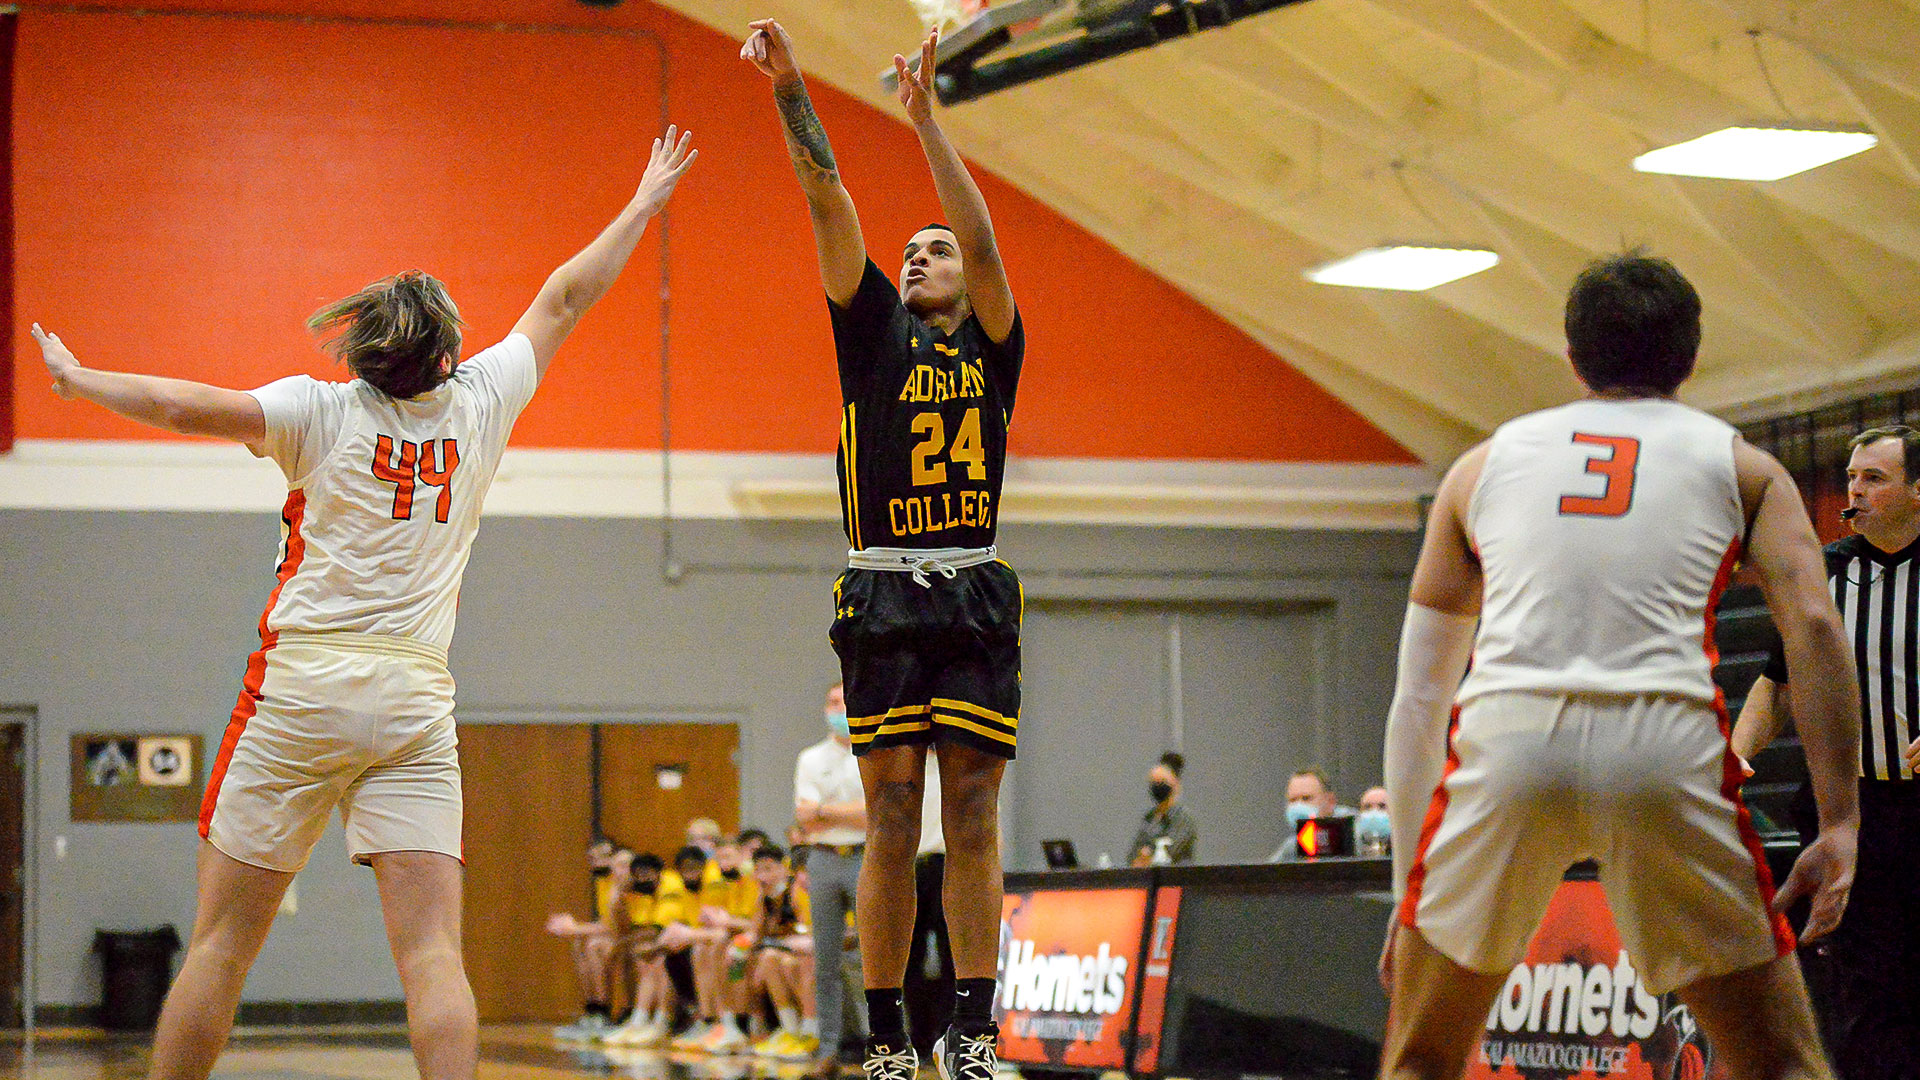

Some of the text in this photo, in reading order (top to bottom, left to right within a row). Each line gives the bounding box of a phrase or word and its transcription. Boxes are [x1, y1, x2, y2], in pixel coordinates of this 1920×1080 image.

[899, 358, 986, 403] ADRIAN
[371, 433, 460, 524] 44
[911, 407, 987, 487] 24
[1558, 431, 1641, 519] 3
[889, 490, 991, 537] COLLEG
[1001, 938, 1129, 1015] Hornets
